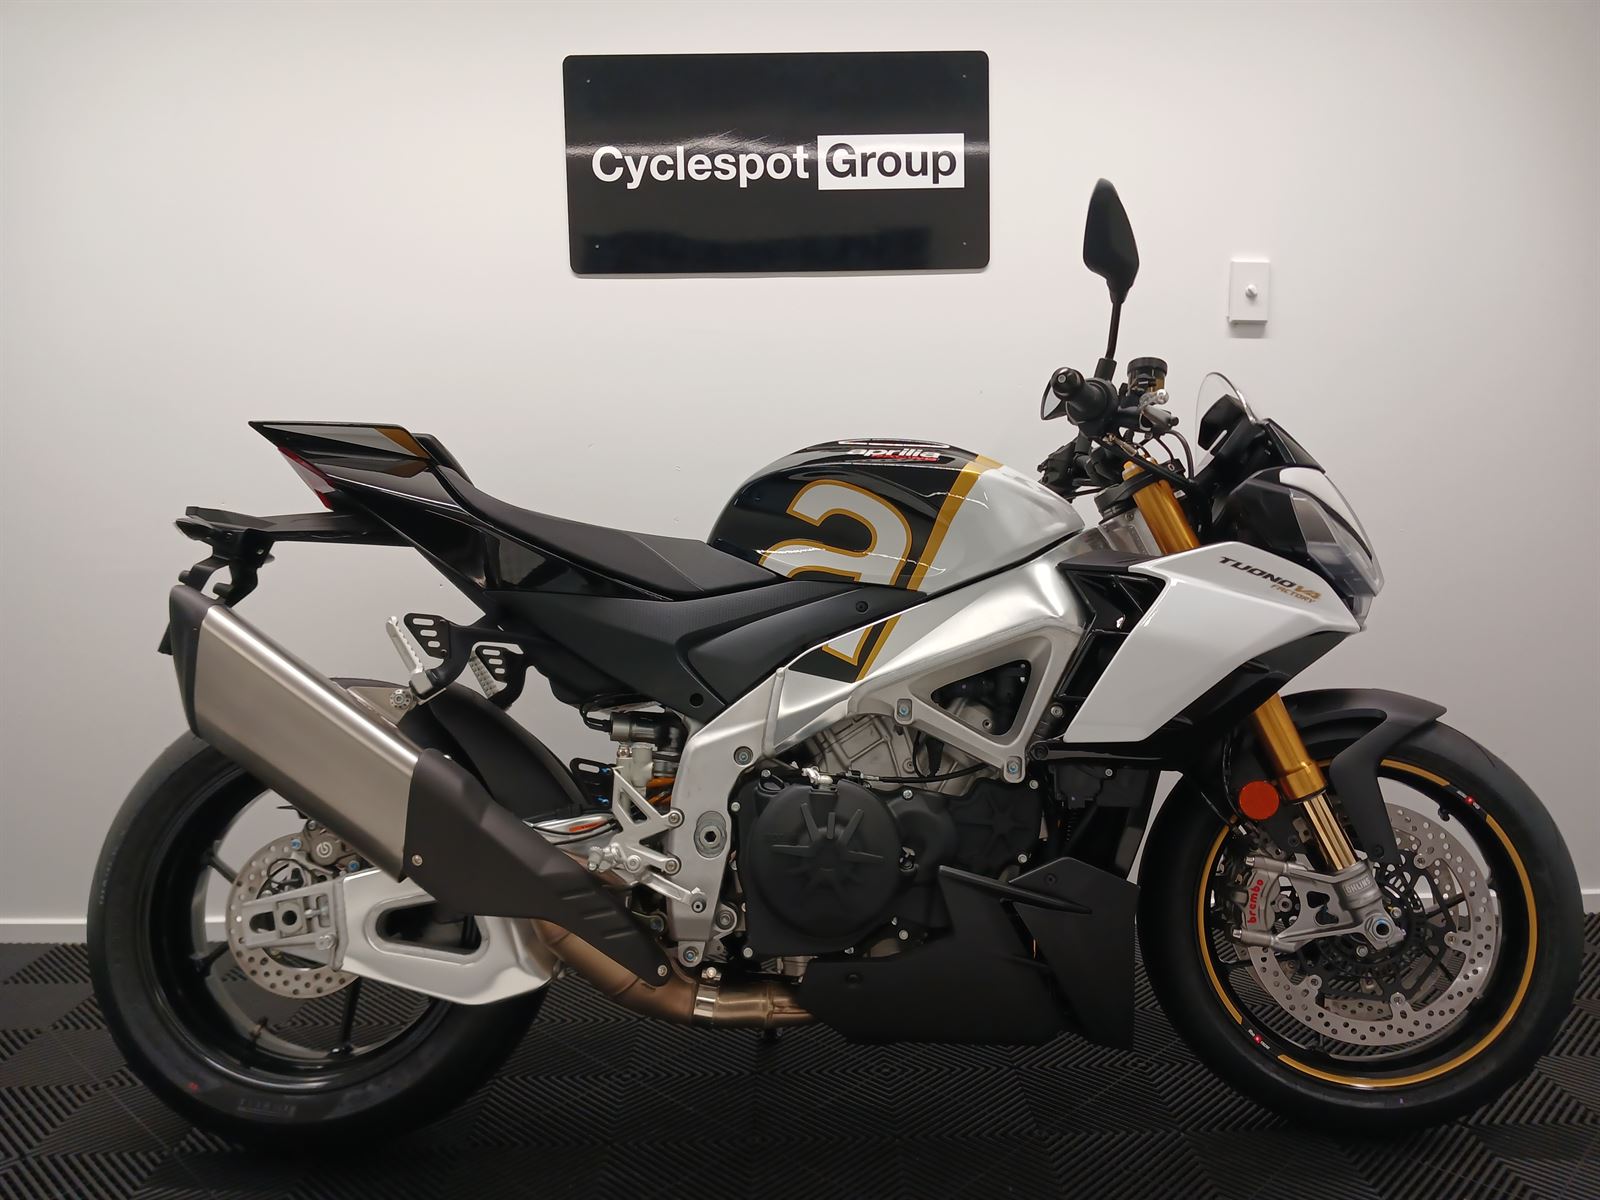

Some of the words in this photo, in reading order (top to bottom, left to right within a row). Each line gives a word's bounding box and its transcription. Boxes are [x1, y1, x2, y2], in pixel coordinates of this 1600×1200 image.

[591, 144, 809, 189] Cyclespot
[825, 142, 957, 184] Group
[847, 448, 942, 458] aprilia
[1219, 556, 1297, 588] TUONO
[1247, 879, 1264, 924] brembo
